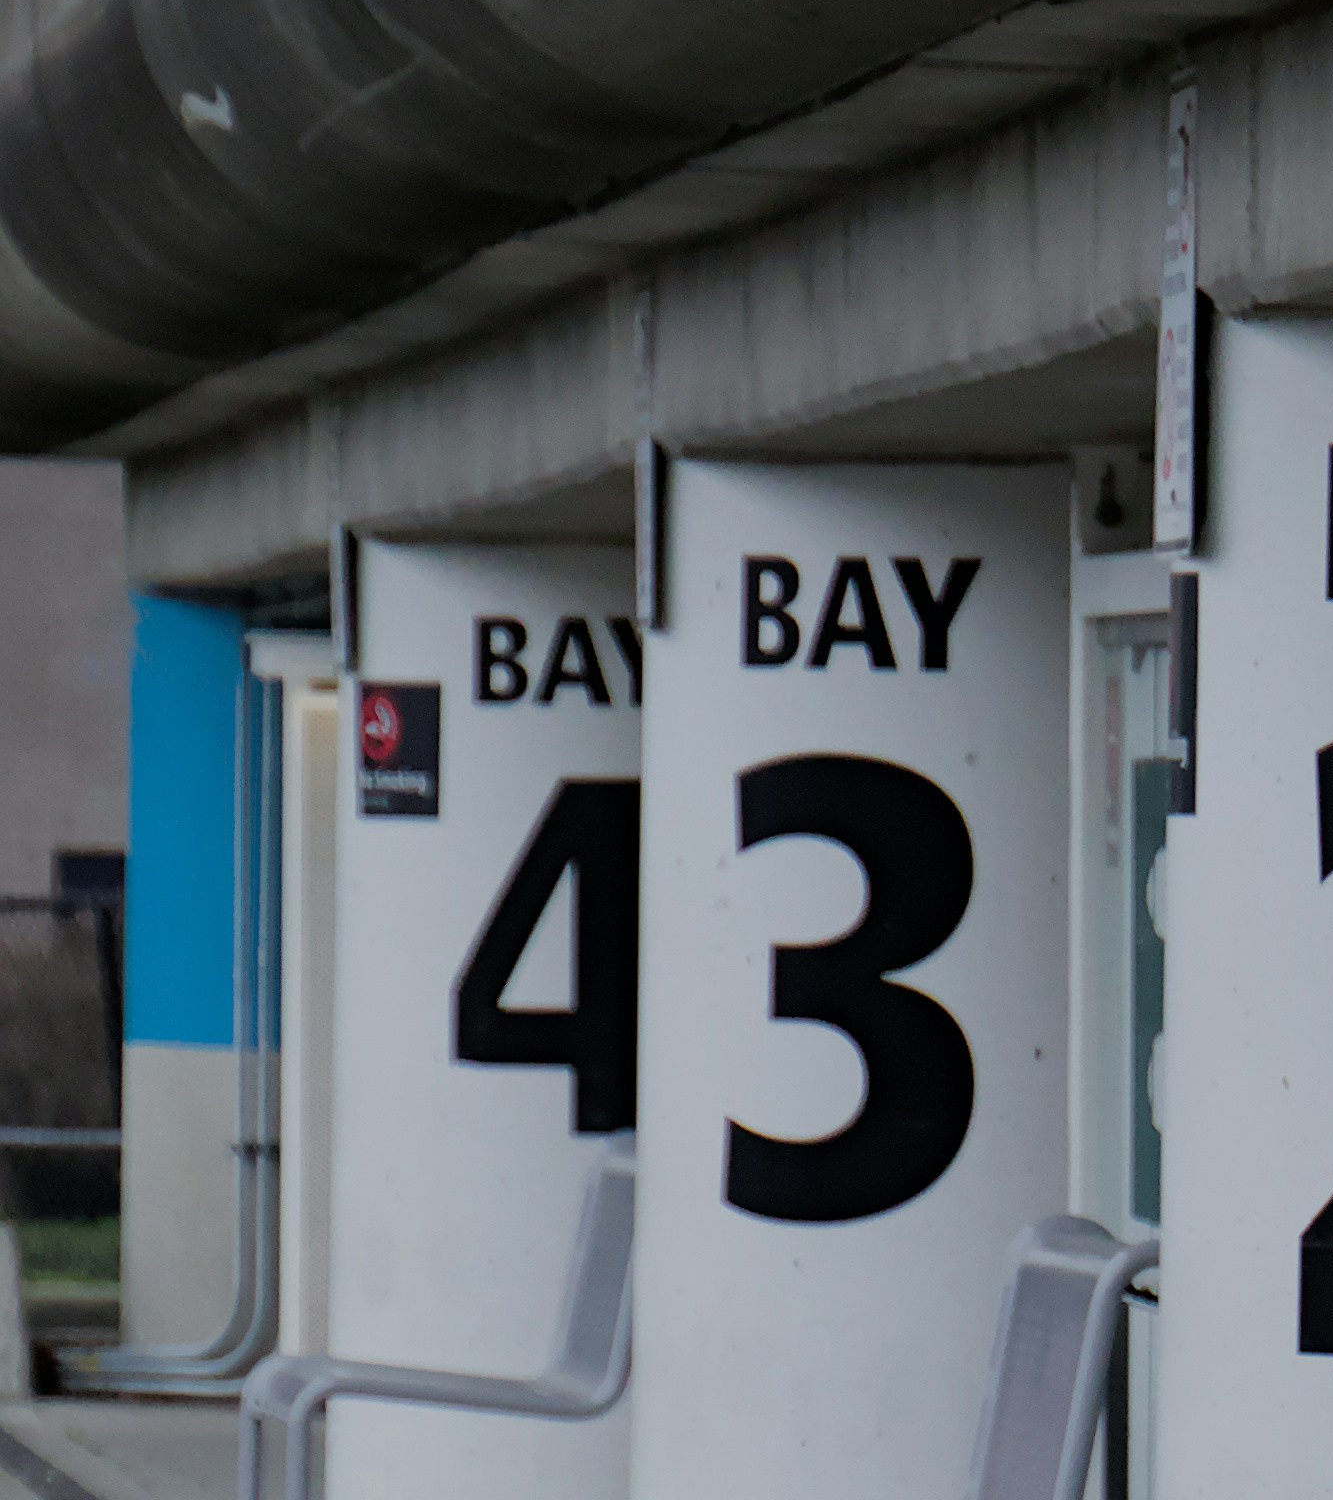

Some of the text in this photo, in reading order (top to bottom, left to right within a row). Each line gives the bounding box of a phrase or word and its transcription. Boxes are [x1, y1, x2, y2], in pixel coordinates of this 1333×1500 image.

[742, 555, 983, 672] BAY
[453, 776, 641, 1138] 4
[724, 753, 976, 1224] 3
